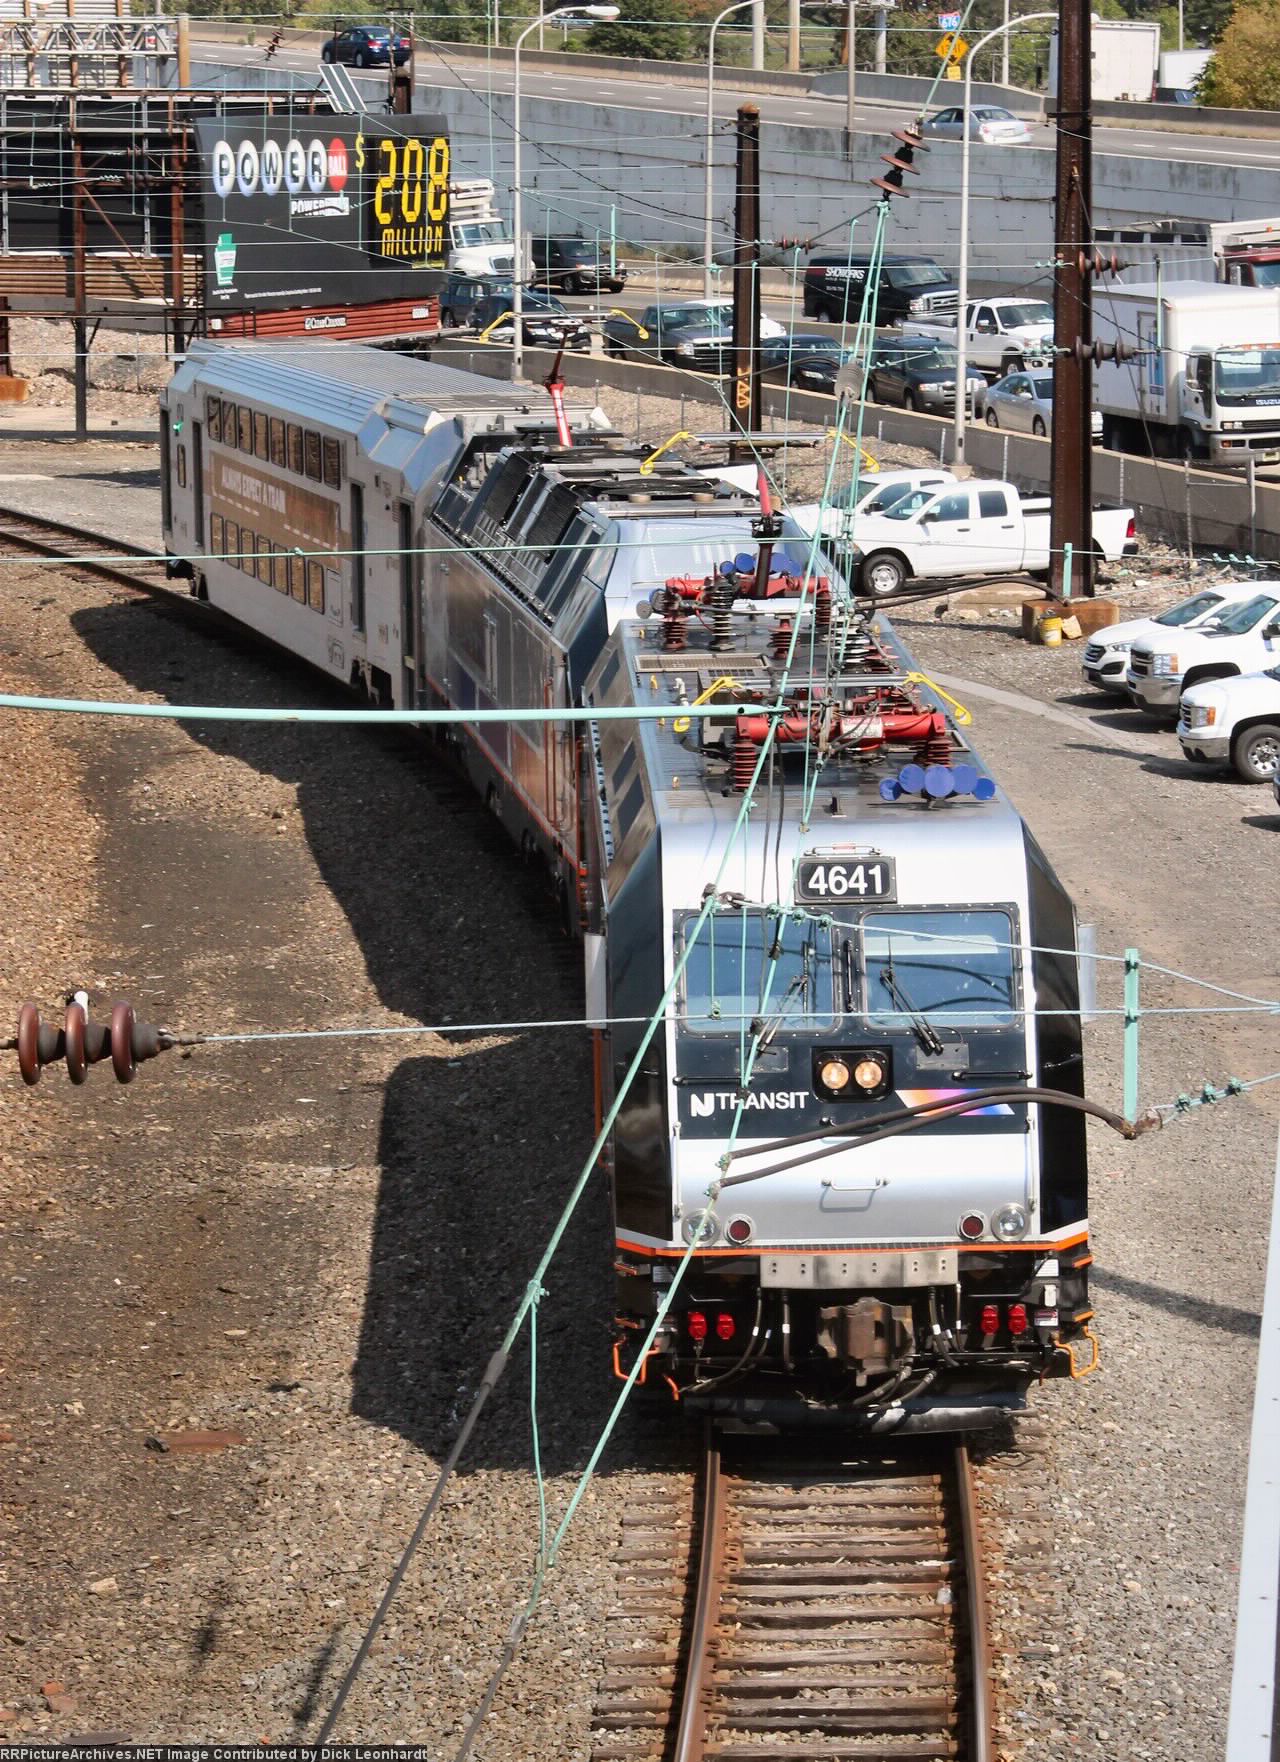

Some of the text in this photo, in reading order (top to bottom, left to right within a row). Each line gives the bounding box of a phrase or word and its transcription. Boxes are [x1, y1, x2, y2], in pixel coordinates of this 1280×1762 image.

[217, 149, 323, 187] POWER
[381, 225, 443, 257] MILLION
[808, 865, 883, 896] 4641
[690, 1091, 809, 1117] NJ TRANSIT
